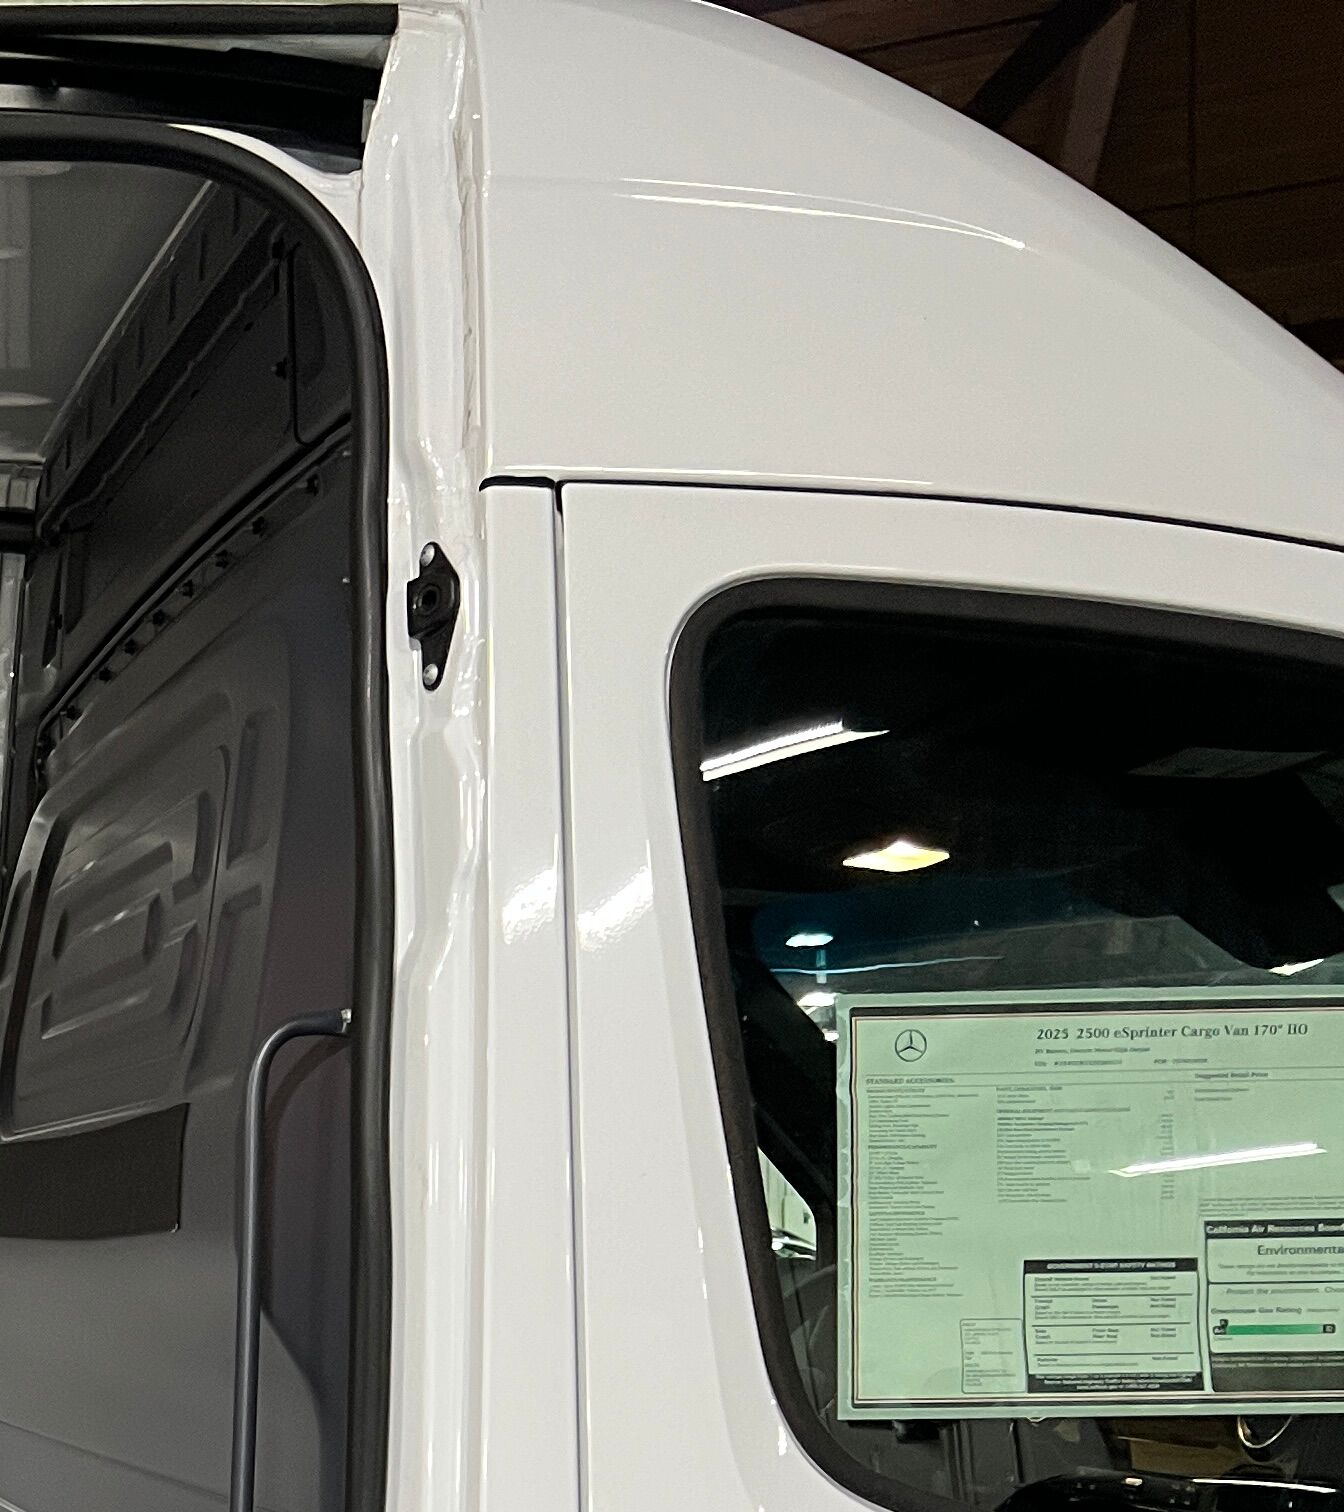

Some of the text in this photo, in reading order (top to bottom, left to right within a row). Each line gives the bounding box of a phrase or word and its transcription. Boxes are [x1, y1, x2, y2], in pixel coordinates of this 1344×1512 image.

[1036, 1028, 1069, 1040] 2025
[1076, 1027, 1110, 1039] 2500
[1114, 1025, 1178, 1041] eSprinter
[1181, 1025, 1220, 1040] Cargo
[1224, 1024, 1249, 1036] Van
